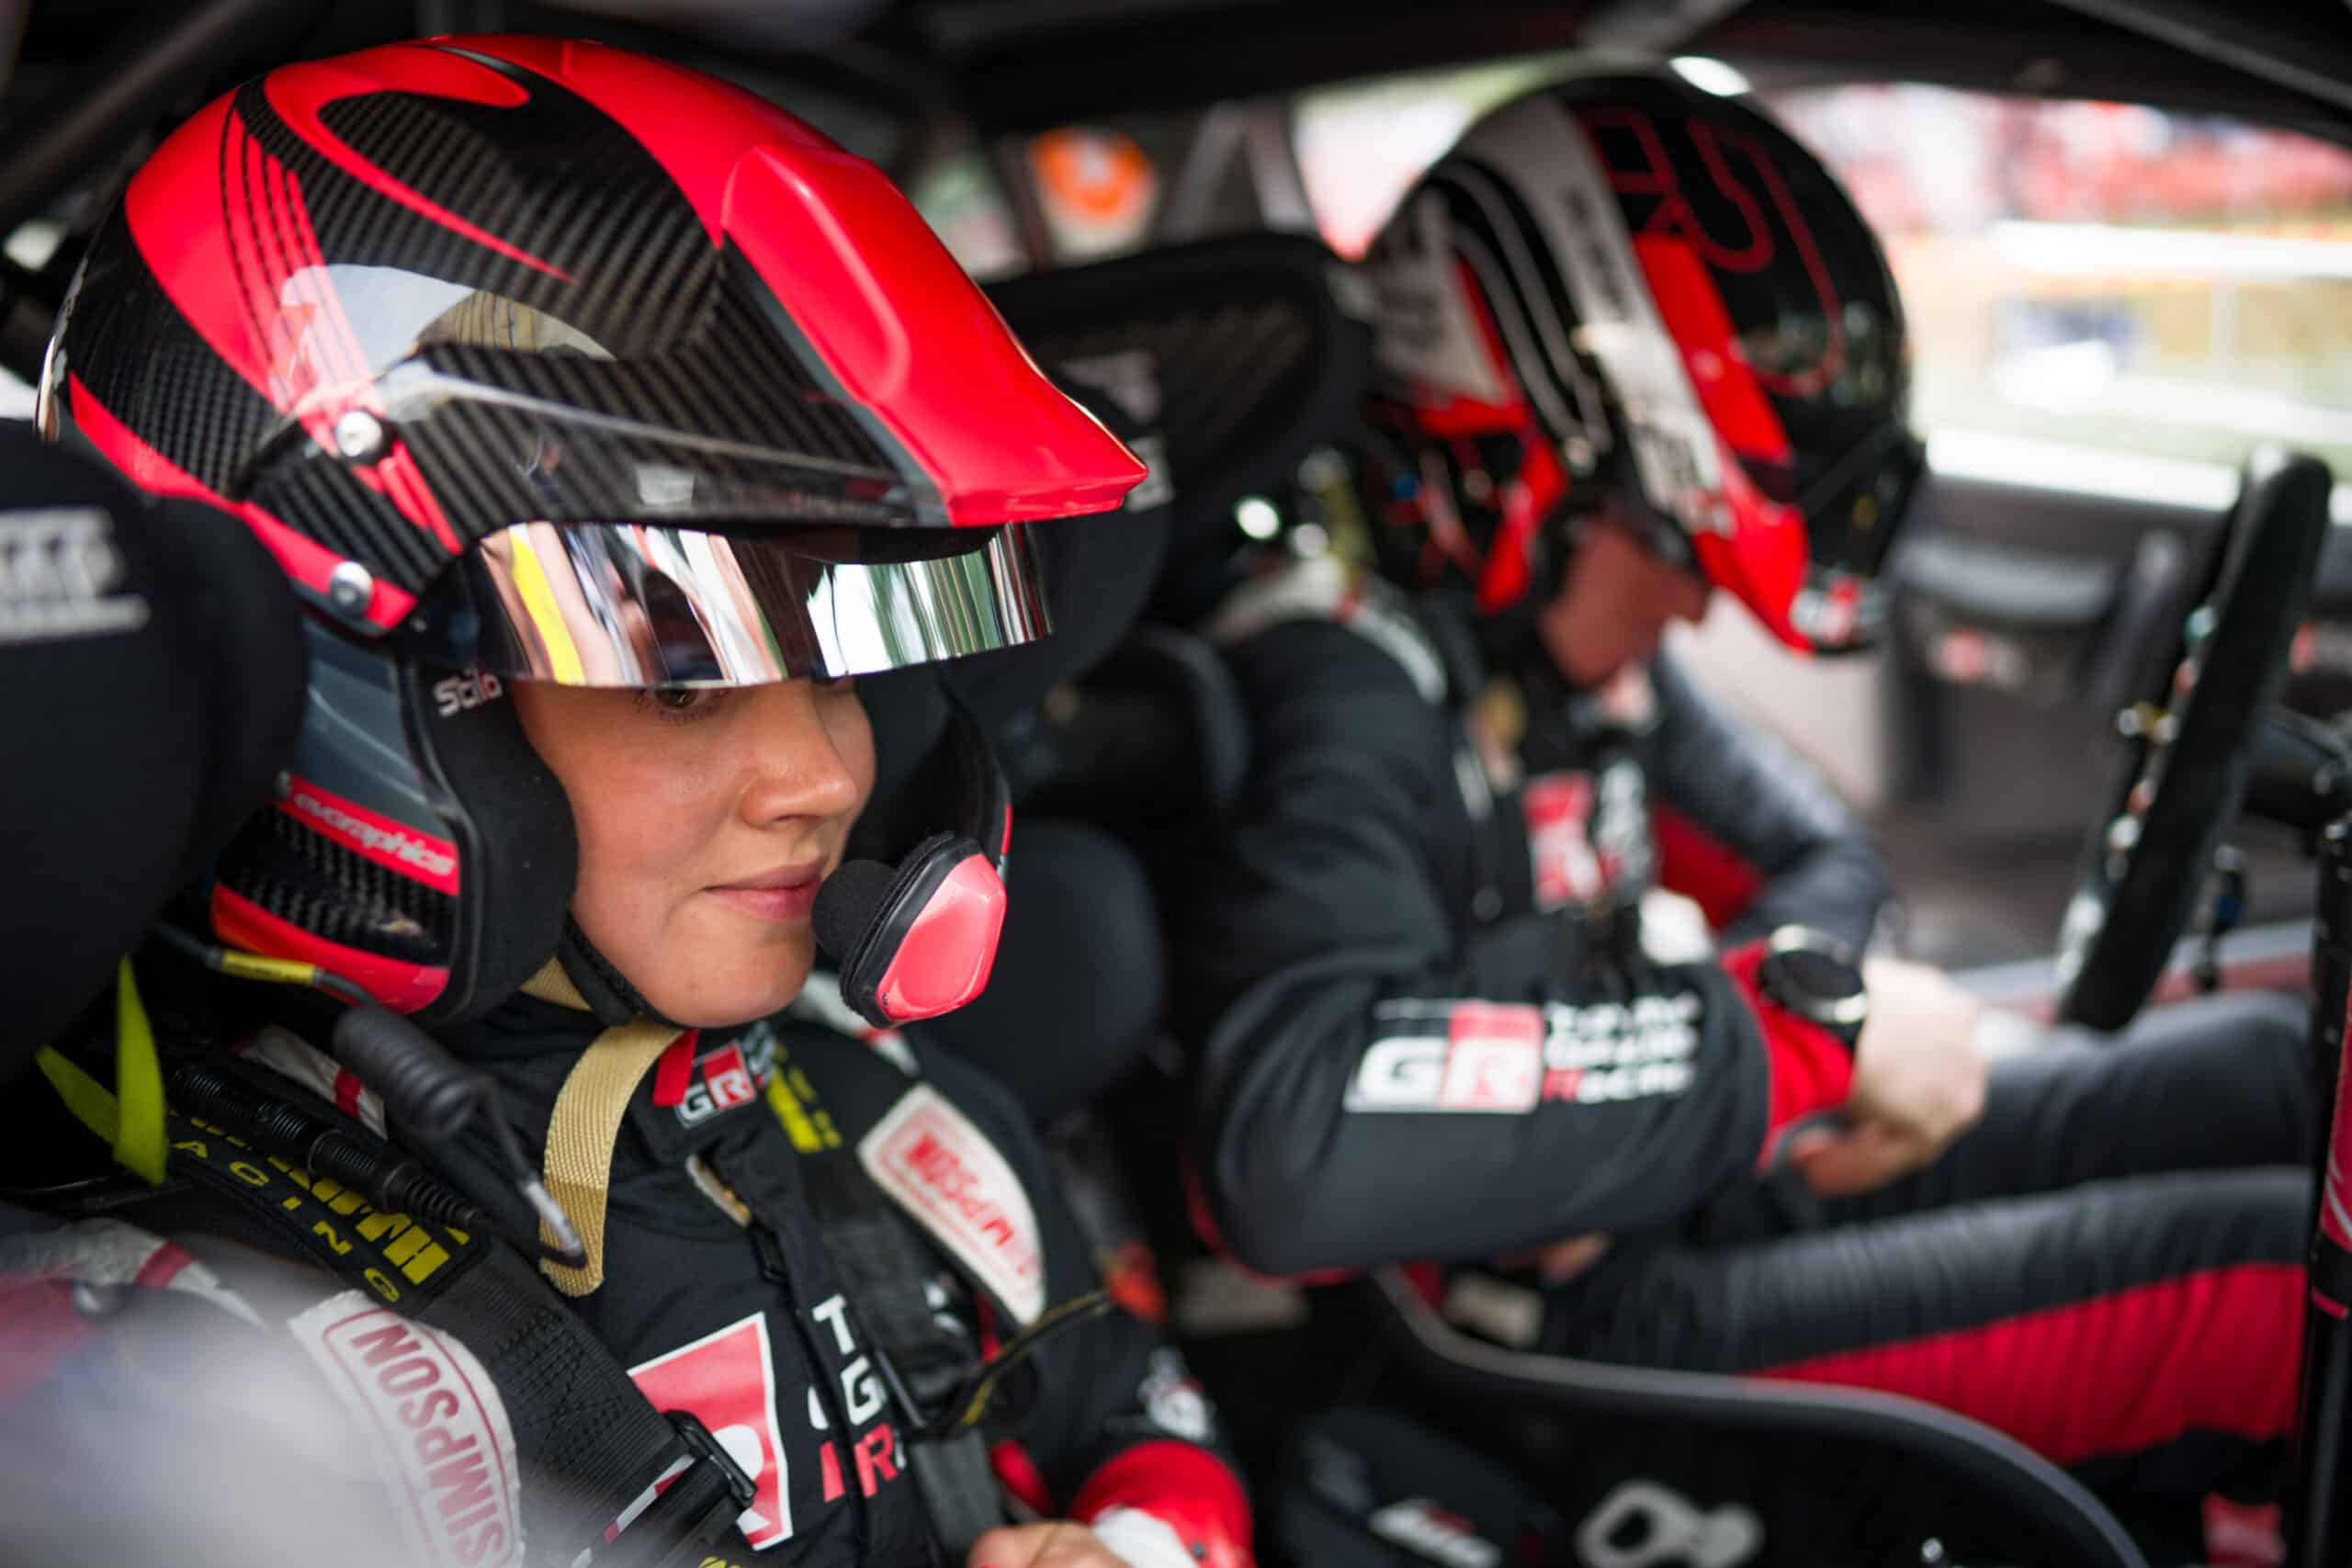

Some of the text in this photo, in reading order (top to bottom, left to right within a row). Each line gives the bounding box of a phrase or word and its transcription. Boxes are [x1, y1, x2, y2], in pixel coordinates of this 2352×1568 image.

[678, 1064, 755, 1125] GR
[1351, 1029, 1534, 1111] GR
[173, 1140, 400, 1303] ACING
[349, 1323, 506, 1567] SIMPSON
